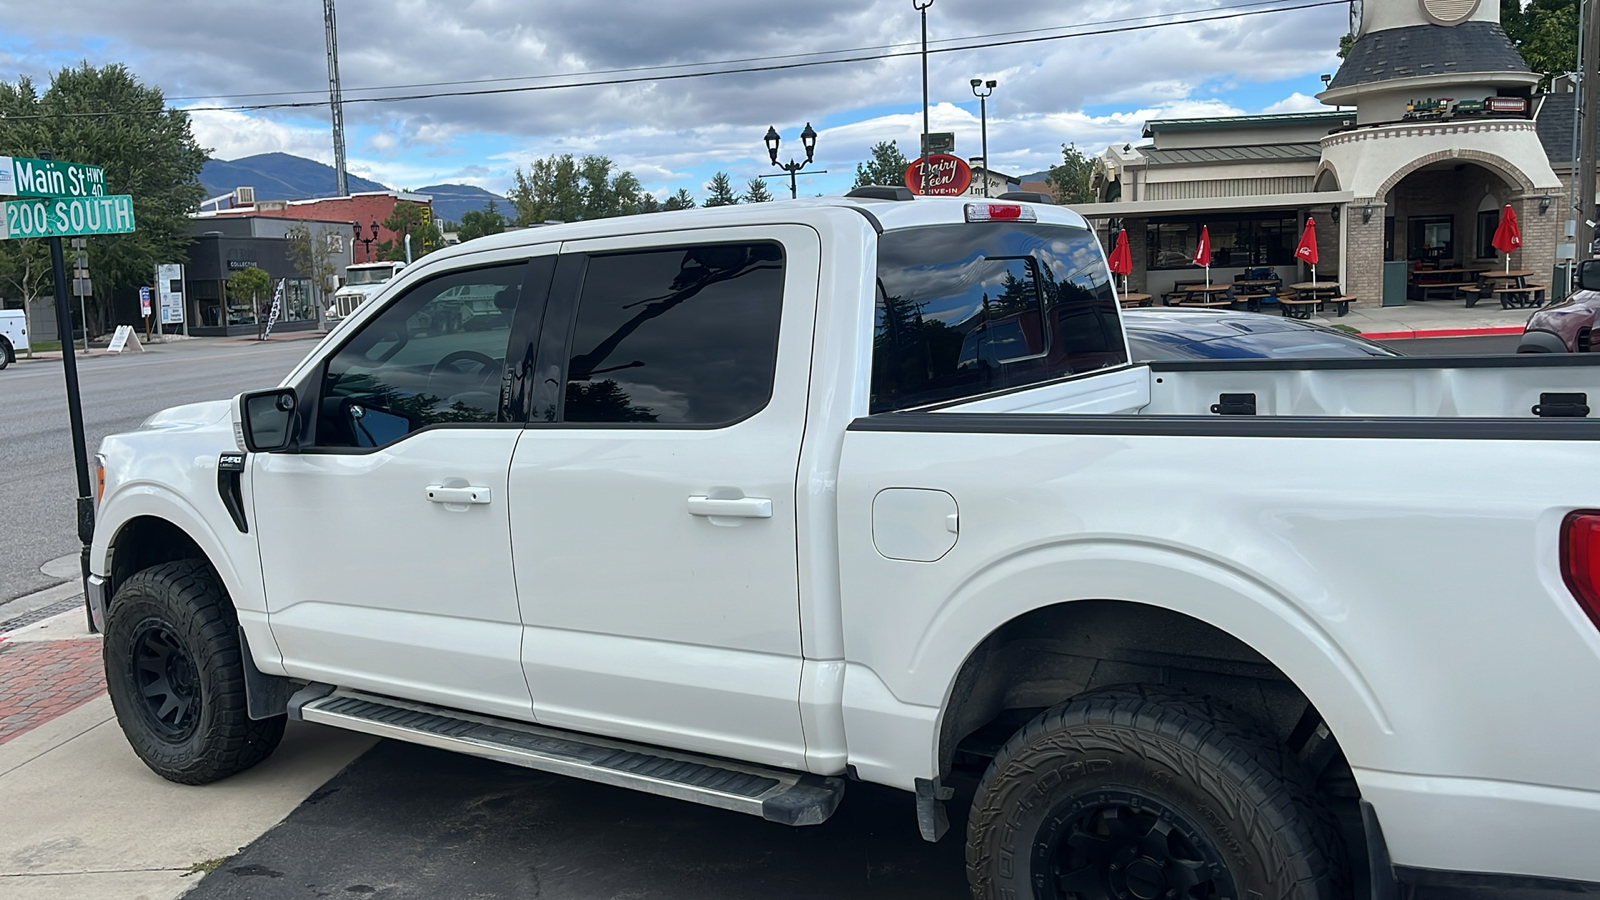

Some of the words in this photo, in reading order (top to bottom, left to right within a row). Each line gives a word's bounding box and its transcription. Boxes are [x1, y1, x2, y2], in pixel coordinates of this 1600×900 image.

[15, 161, 66, 195] Main
[67, 165, 88, 196] St
[85, 167, 104, 183] HWY
[91, 184, 103, 197] 40
[8, 202, 47, 234] 200
[55, 199, 131, 233] SOUTH
